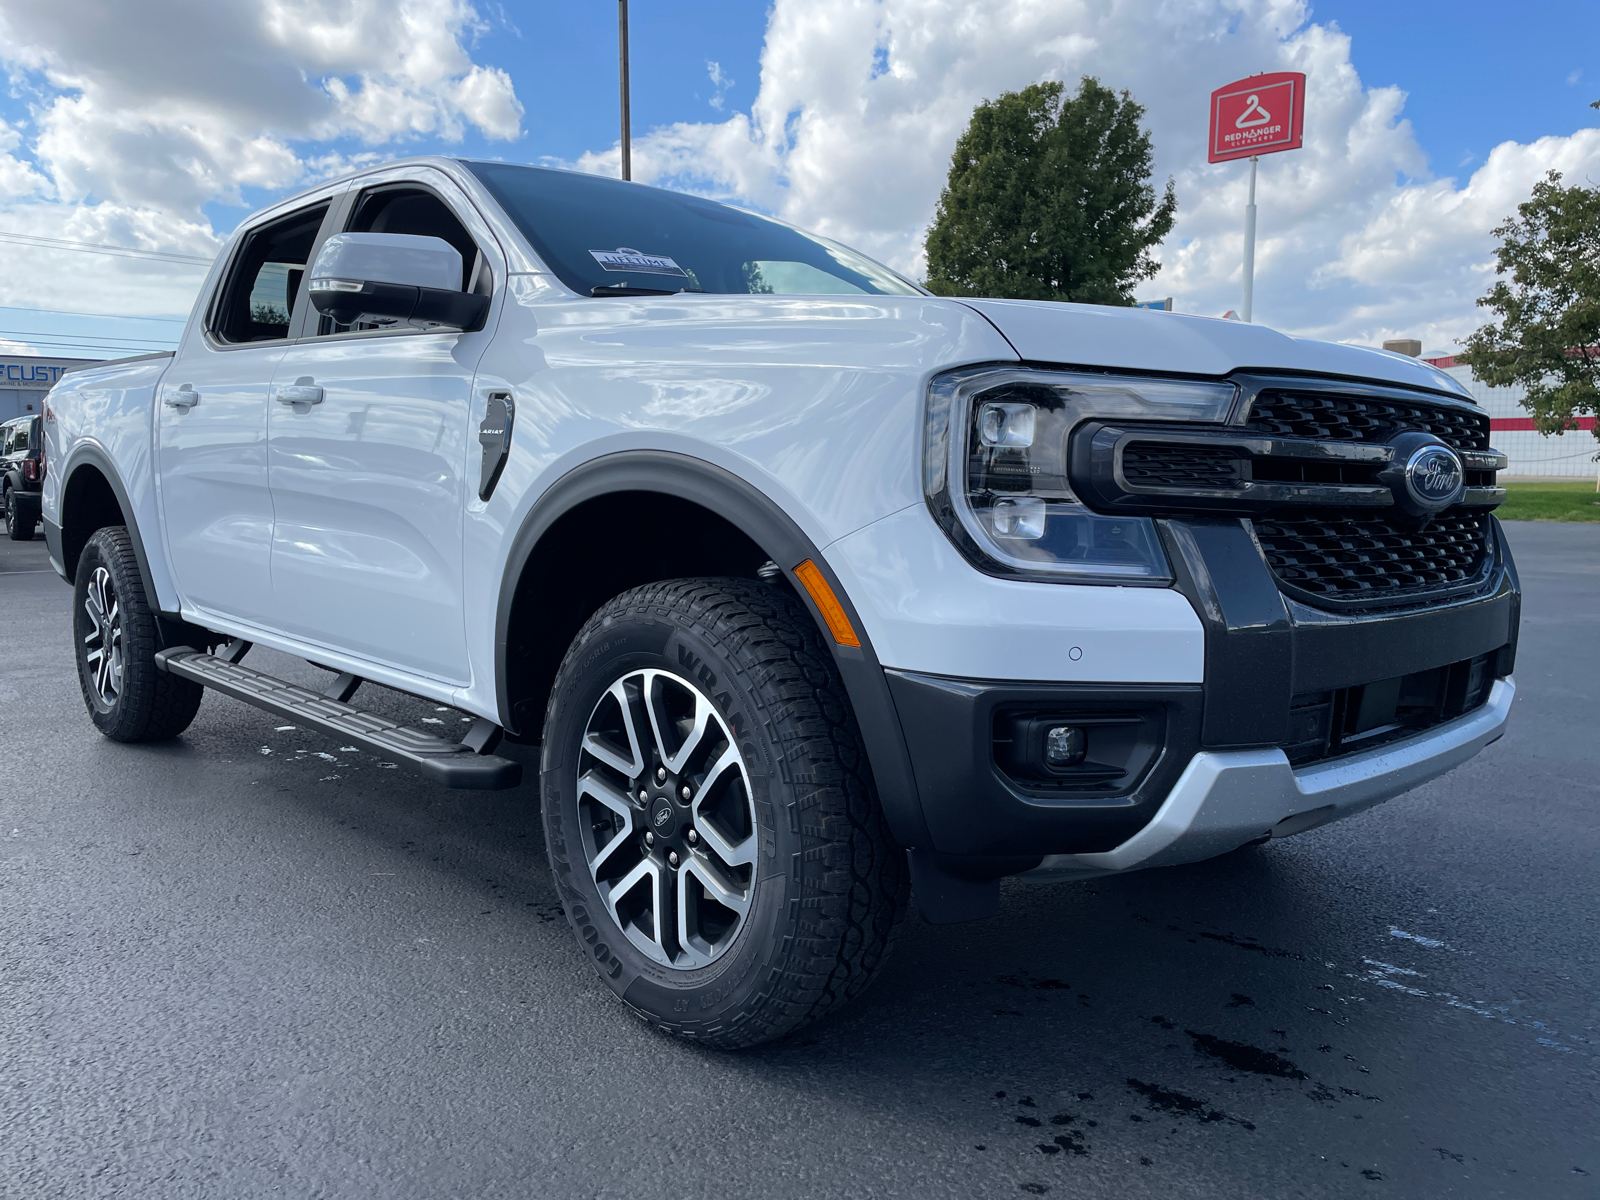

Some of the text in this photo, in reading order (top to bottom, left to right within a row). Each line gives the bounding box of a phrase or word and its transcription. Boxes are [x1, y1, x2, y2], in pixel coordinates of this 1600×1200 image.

[1224, 125, 1281, 142] RED HANGER
[1231, 134, 1273, 147] CLEANERS
[604, 255, 670, 268] LIFETIME
[1424, 457, 1455, 490] Ford
[677, 642, 776, 859] WRANGLER
[656, 810, 669, 825] Ford
